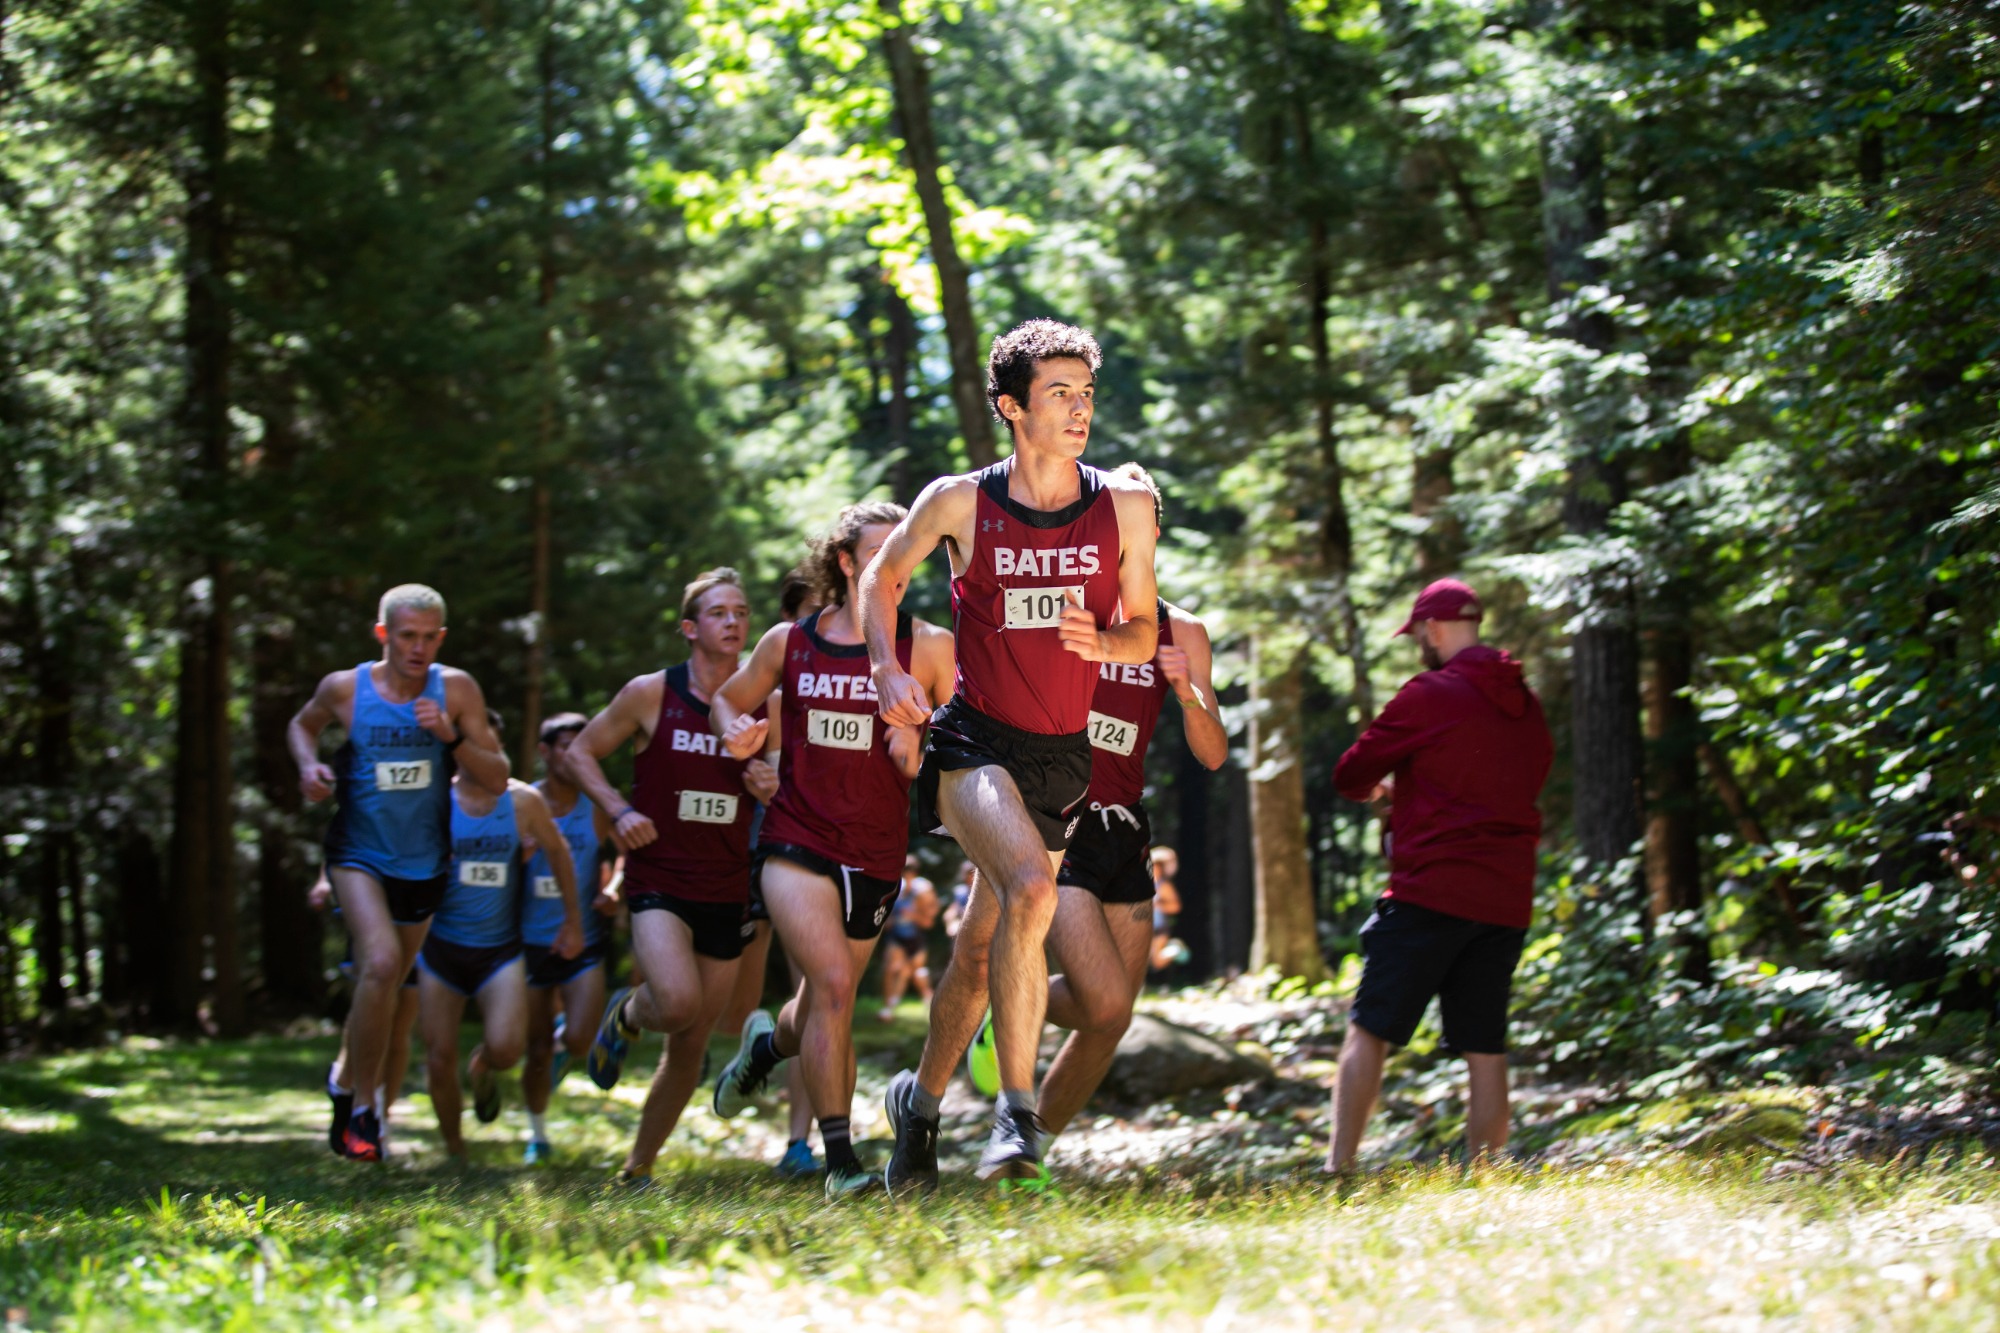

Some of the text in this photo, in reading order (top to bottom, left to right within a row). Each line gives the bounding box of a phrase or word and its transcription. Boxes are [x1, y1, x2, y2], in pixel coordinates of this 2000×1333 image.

[821, 718, 859, 742] 109
[1094, 720, 1126, 747] 124
[390, 766, 420, 784] 127
[693, 797, 726, 817] 115
[471, 866, 498, 881] 136
